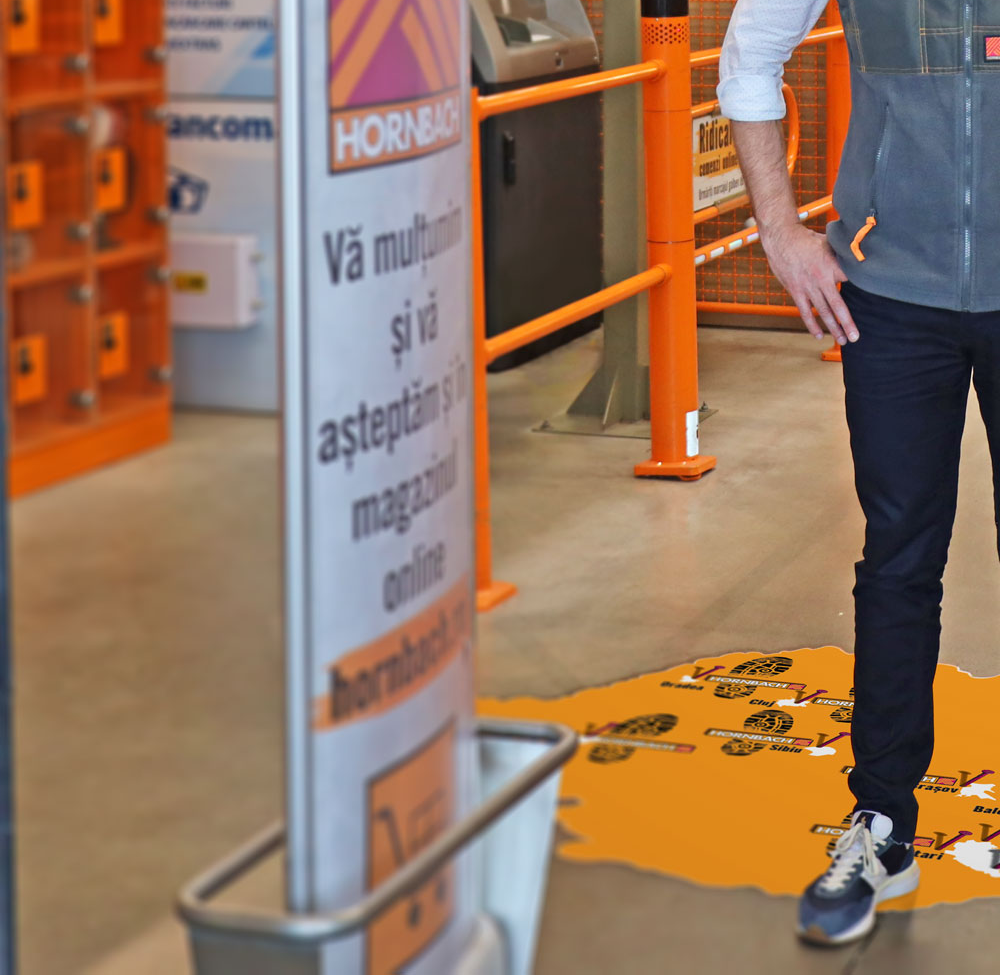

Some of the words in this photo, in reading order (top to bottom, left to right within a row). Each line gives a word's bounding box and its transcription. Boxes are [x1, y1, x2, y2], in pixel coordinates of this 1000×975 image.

[333, 95, 461, 163] HORNBACH
[322, 223, 366, 287] Vă
[390, 298, 413, 372] și
[416, 287, 441, 346] vă
[317, 374, 440, 473] așteptăm
[351, 437, 457, 542] magazinul
[382, 540, 446, 613] online
[711, 675, 788, 689] HORNBACH
[749, 698, 777, 707] Cluj
[709, 730, 794, 745] HORNBACH
[769, 744, 803, 754] Sibiu
